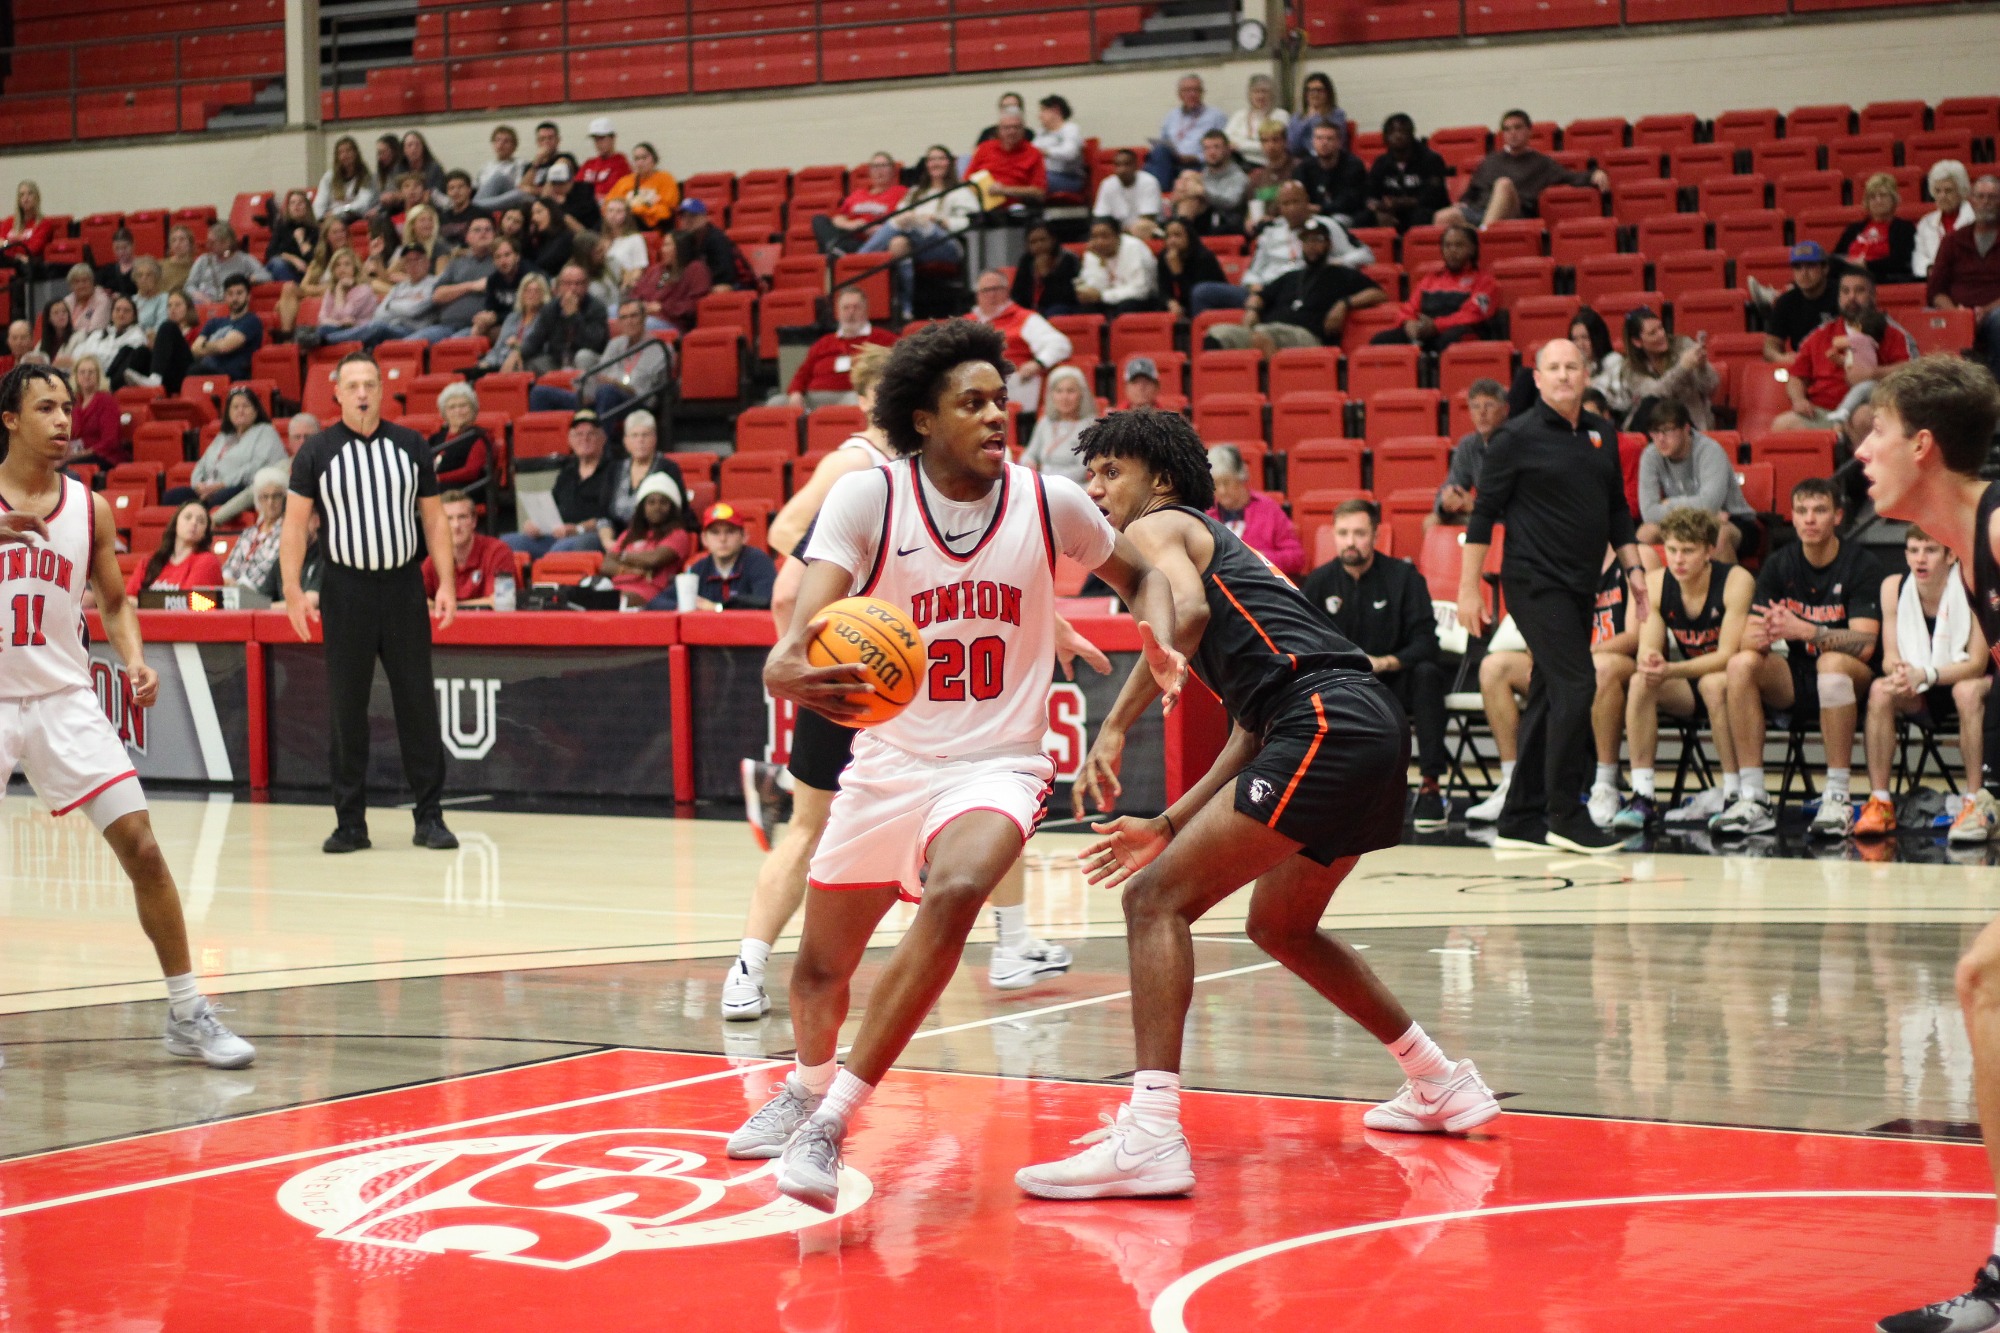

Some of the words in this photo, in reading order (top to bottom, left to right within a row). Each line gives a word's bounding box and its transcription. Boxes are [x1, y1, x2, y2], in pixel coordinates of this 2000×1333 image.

[0, 547, 73, 593] NION
[11, 594, 46, 646] 11
[866, 604, 916, 649] NCAA
[911, 580, 1022, 630] UNION
[835, 620, 903, 690] Wilson
[928, 635, 1006, 702] 20
[435, 679, 501, 760] U
